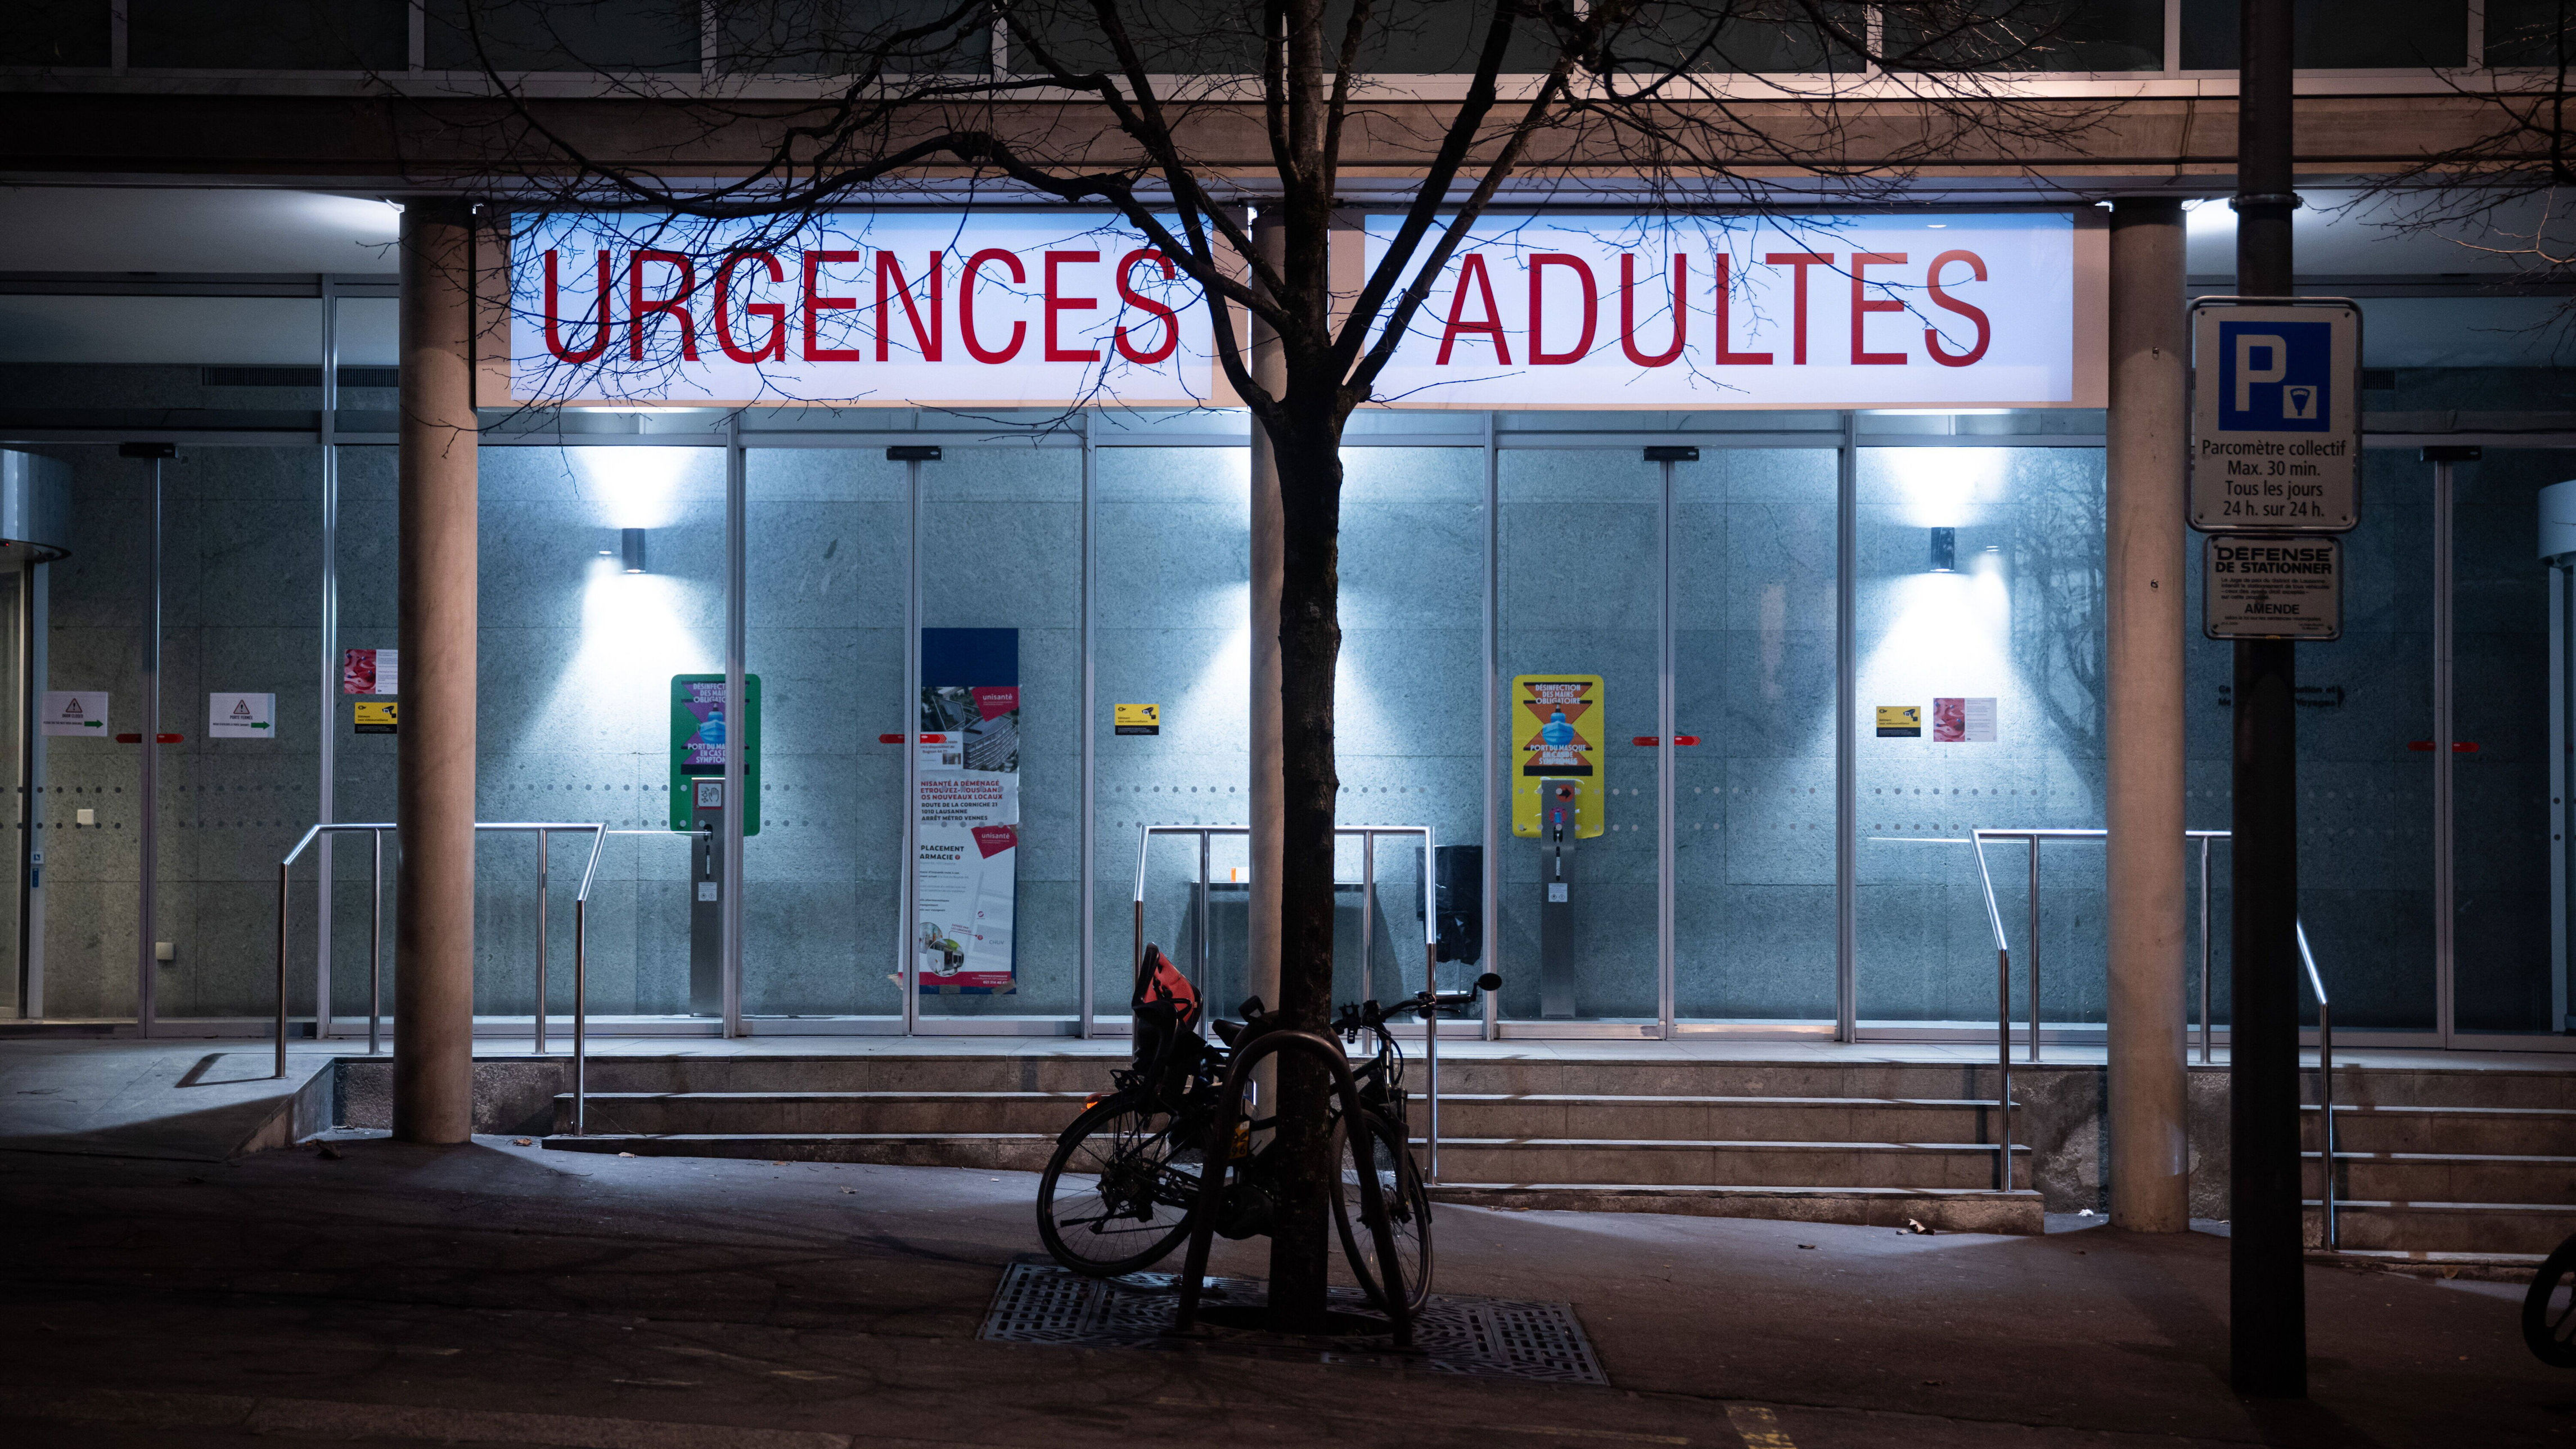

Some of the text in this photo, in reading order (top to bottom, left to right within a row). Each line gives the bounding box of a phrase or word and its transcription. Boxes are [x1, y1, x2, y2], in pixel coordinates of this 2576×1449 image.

[543, 248, 1991, 367] URGENCES ADULTES
[2235, 334, 2286, 411] P
[2202, 439, 2347, 456] Parcomètre collectif
[2227, 460, 2321, 476] Max. 30 min.
[2225, 480, 2323, 500] Tous les jours
[2223, 500, 2325, 517] 24 h. sur 24 h.
[2215, 562, 2332, 574] DE STATIONNER
[2245, 604, 2300, 614] AMENDE
